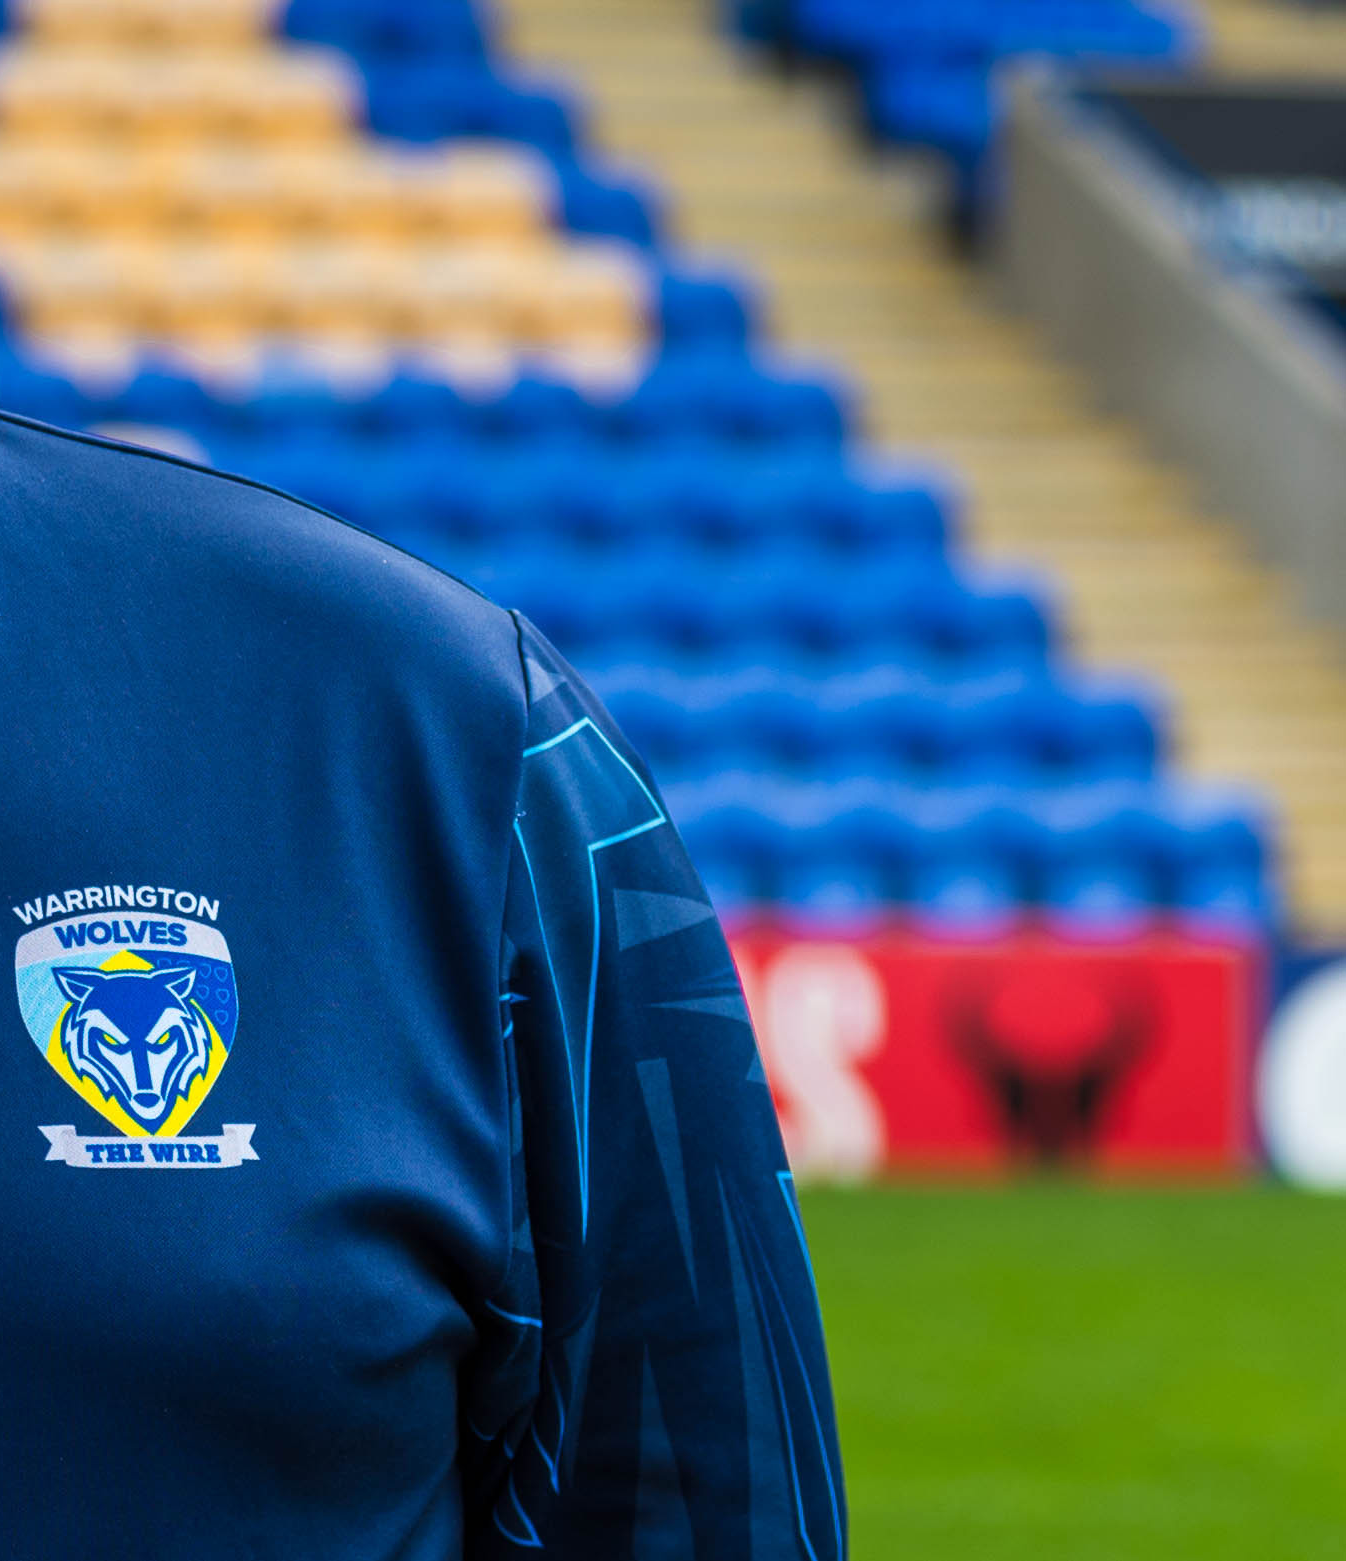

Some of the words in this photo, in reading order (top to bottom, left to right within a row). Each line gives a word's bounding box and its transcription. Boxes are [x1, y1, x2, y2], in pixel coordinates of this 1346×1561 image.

[12, 884, 221, 926] WARRINGTON
[53, 919, 188, 950] WOLVES
[85, 1143, 145, 1164] THE
[148, 1143, 222, 1164] WIRE
